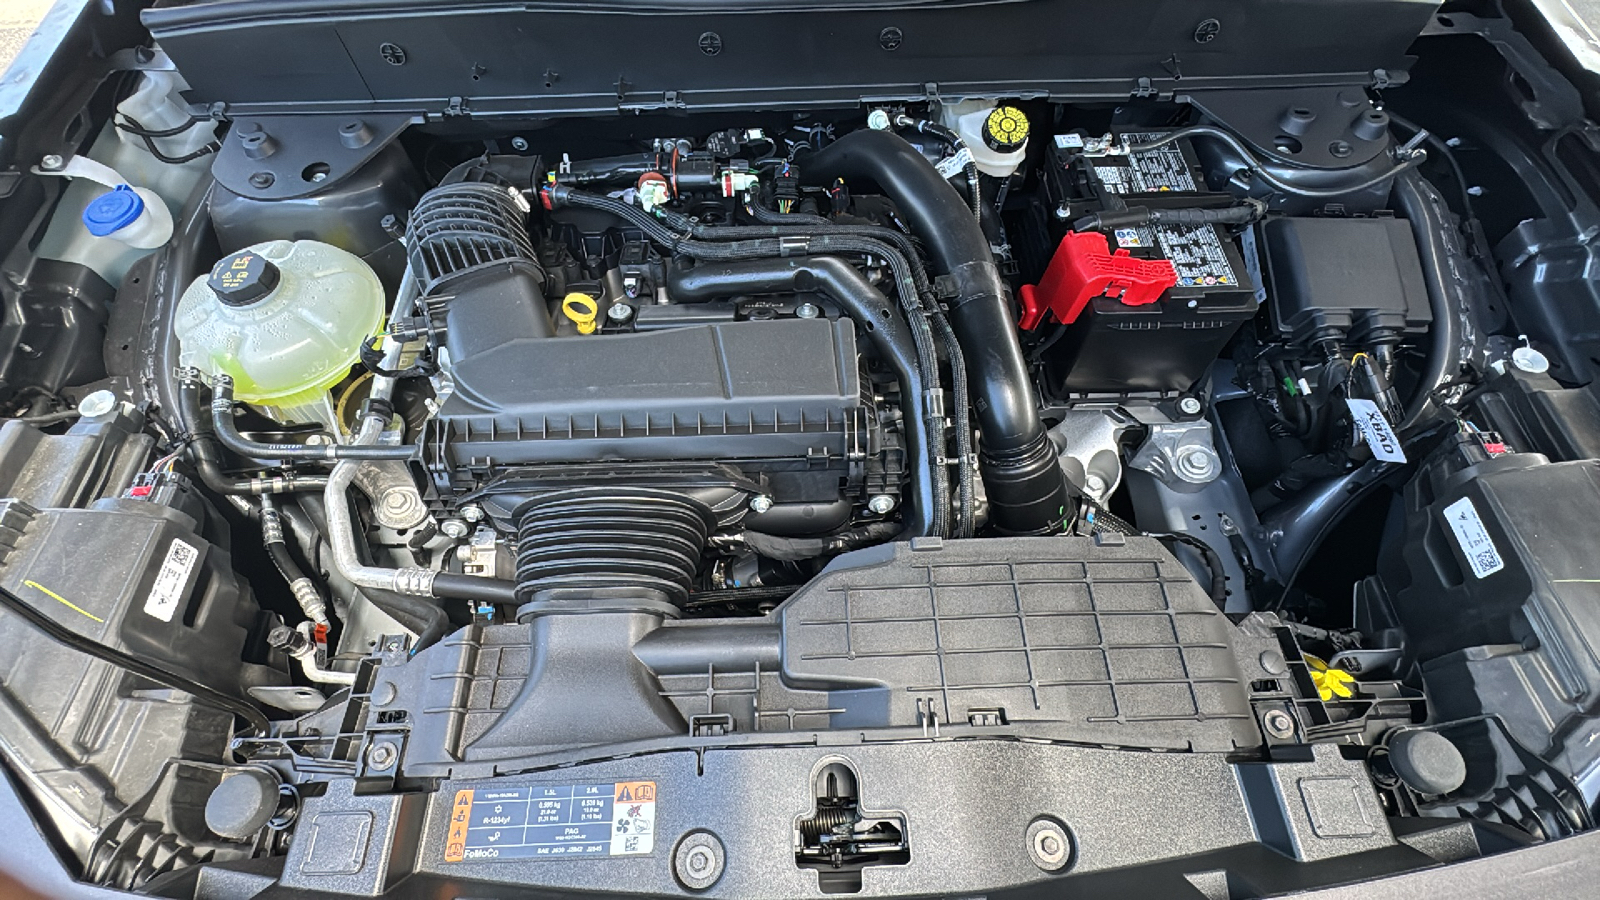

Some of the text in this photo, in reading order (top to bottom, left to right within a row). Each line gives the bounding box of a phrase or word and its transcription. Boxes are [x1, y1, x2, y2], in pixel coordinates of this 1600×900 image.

[1366, 411, 1394, 454] XBAD
[483, 816, 511, 825] R-1234yf
[564, 827, 579, 835] PAG
[463, 848, 499, 858] FoMoCo
